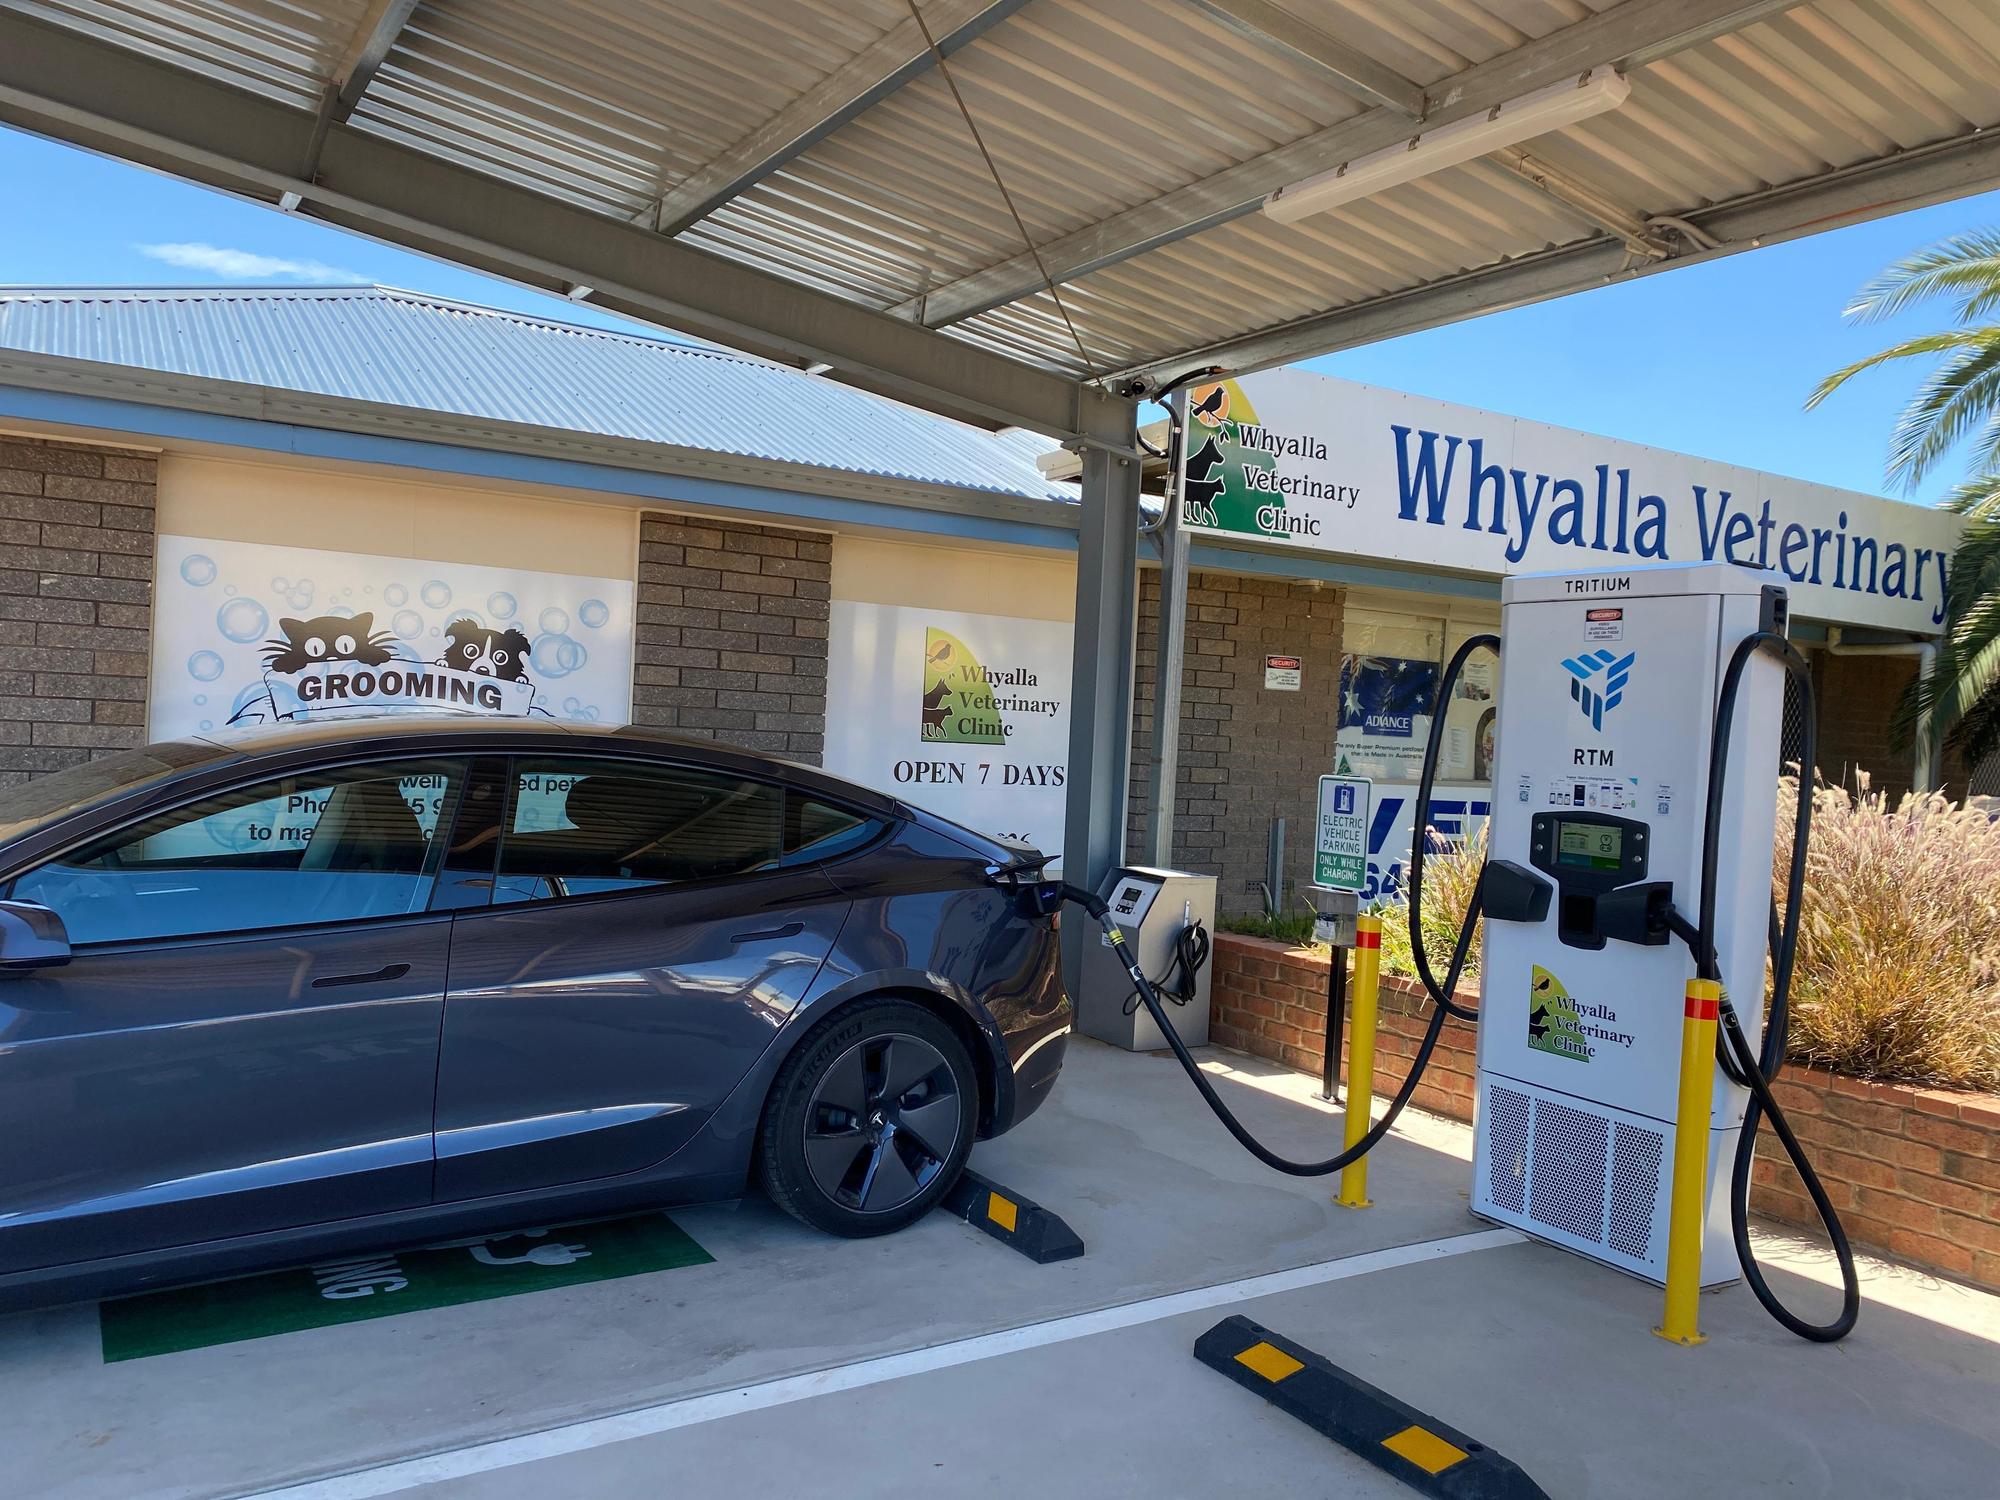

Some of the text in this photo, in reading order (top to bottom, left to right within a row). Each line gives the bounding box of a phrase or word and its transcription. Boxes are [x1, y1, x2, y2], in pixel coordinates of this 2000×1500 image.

[1239, 424, 1328, 461] Whyalla
[1244, 465, 1361, 507] Veterinary
[1257, 507, 1321, 536] Clinic
[1391, 424, 1950, 624] Whyalla Veterinary
[1565, 577, 1631, 593] TRITIUM
[961, 665, 1038, 688] Whyalla
[297, 671, 502, 711] GROOMING
[959, 691, 1060, 717] Veterinary
[958, 718, 1013, 737] Clinic
[1365, 715, 1409, 729] ADVANCE
[1574, 749, 1613, 766] RTM
[402, 776, 441, 788] well
[894, 761, 1064, 786] OPEN 7 DAYS
[249, 824, 272, 840] to
[1323, 815, 1363, 829] ELECTRIC
[1325, 827, 1360, 841] VEHICLE
[1323, 840, 1360, 854] PARKING
[1320, 854, 1362, 870] ONLY WHILE
[1322, 866, 1358, 881] CHARGING
[1556, 996, 1617, 1022] Whyalla
[1555, 1016, 1635, 1048] Veterinary
[1554, 1036, 1596, 1057] Clinic
